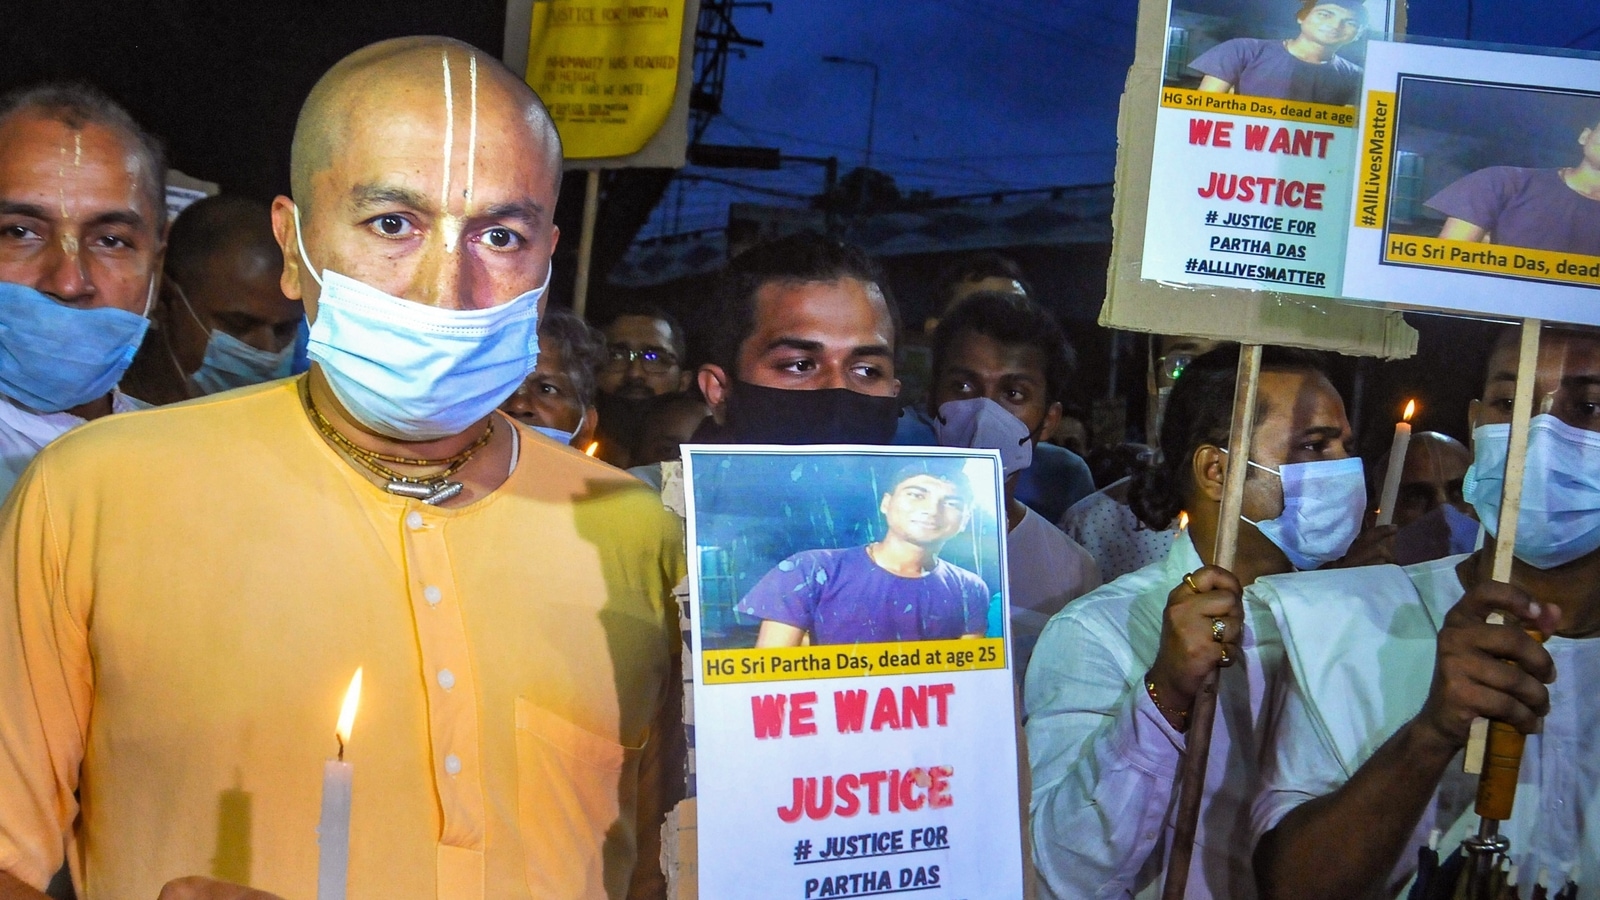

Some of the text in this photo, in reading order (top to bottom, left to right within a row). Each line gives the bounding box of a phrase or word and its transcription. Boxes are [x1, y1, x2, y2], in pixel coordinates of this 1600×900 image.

[1164, 92, 1353, 124] HG Sri Partha Das, dead at age
[1188, 118, 1334, 159] WE WANT
[1361, 100, 1388, 226] #AllLivesMatter
[1198, 171, 1326, 210] JUSTICE
[1205, 210, 1316, 235] # JUSTICE FOR
[1210, 236, 1307, 258] PARTHA DAS
[1391, 241, 1600, 278] HG Sri Partha Das, dead
[1185, 258, 1326, 286] #ALLLIVESMATTER
[706, 646, 997, 676] HG Sri Partha Das, dead at age 25
[751, 683, 956, 739] WE WANT
[777, 765, 954, 823] JUSTICE
[794, 826, 948, 861] # JUSTICE FOR
[805, 865, 940, 899] PARTHA DAS
